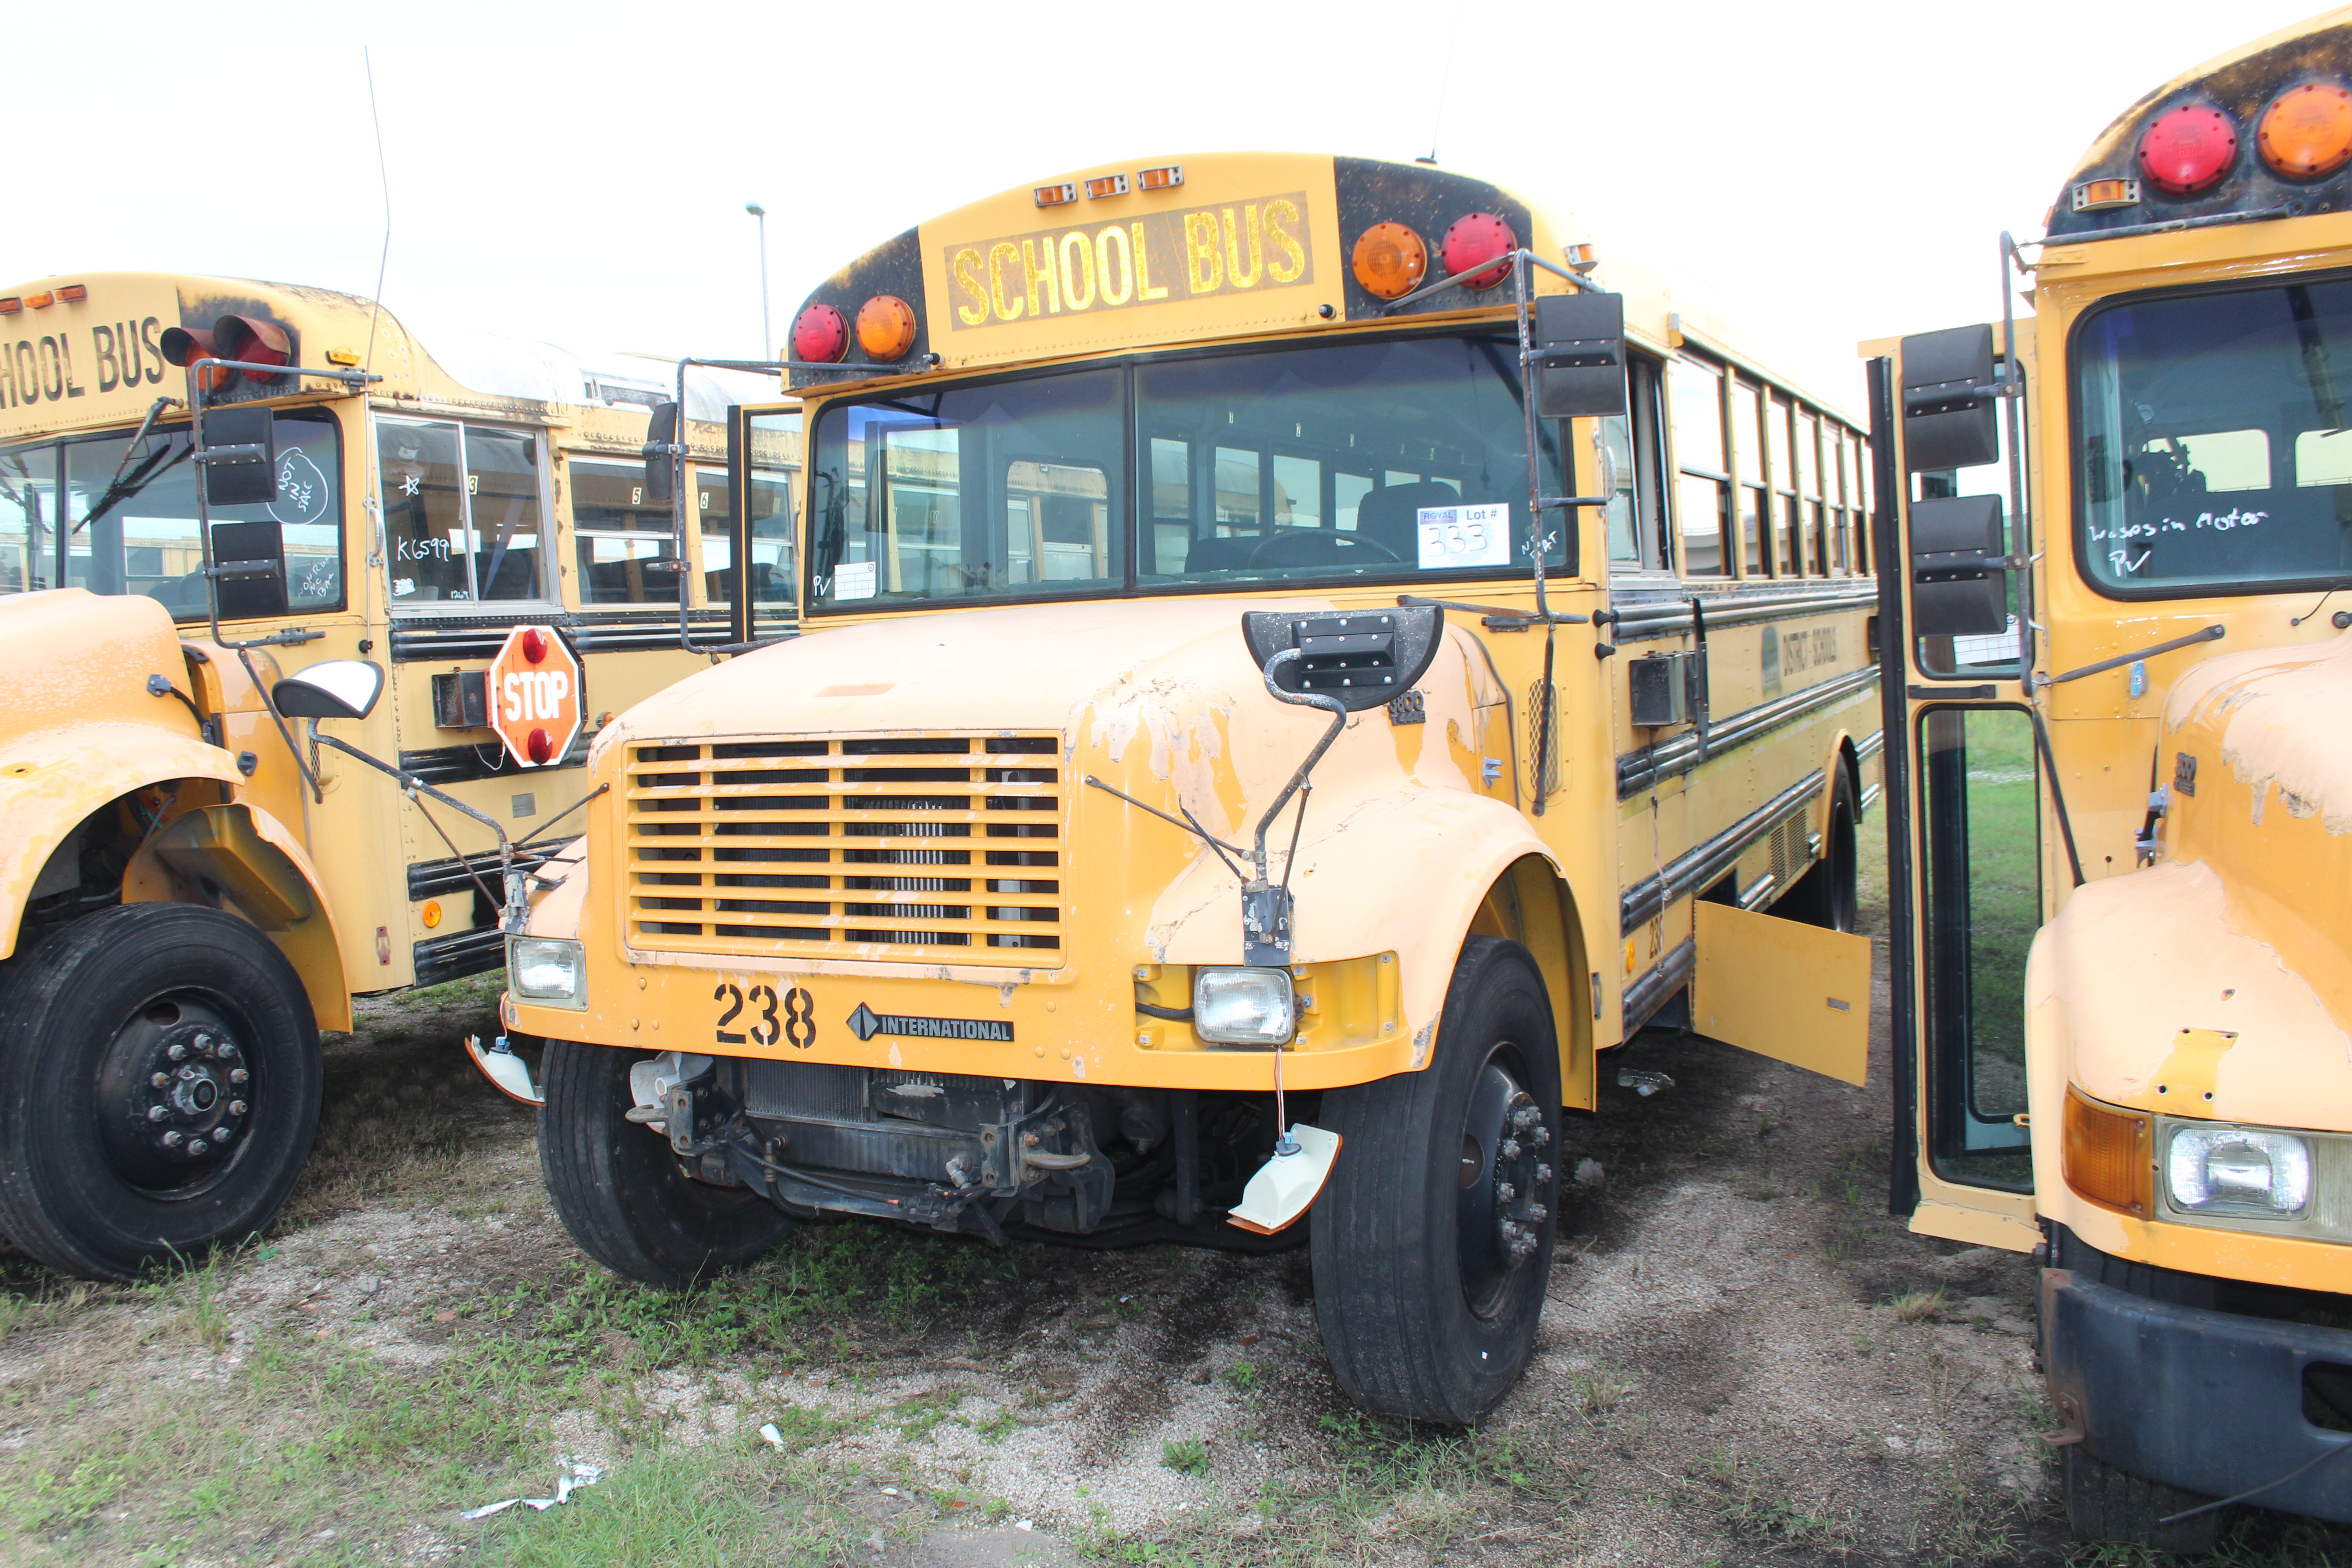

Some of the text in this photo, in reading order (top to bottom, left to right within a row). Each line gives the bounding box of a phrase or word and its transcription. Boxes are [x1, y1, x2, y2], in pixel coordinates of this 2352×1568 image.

[954, 198, 1305, 326] SCHOOL BUS
[93, 316, 167, 393] BUS
[278, 457, 295, 490] NOT
[470, 477, 476, 493] 3
[289, 482, 301, 500] IN
[634, 489, 640, 503] 5
[701, 493, 707, 507] 6
[1424, 511, 1454, 520] ROYAL
[1467, 508, 1497, 520] Lot #
[2161, 517, 2186, 532] in
[397, 536, 450, 562] K6599
[1428, 524, 1487, 557] 333
[2109, 550, 2152, 577] PV
[451, 590, 469, 600] 1269
[813, 575, 831, 597] PV
[504, 671, 568, 721] STOP
[714, 984, 816, 1049] 238
[882, 1016, 1010, 1041] INTERNATIONAL
